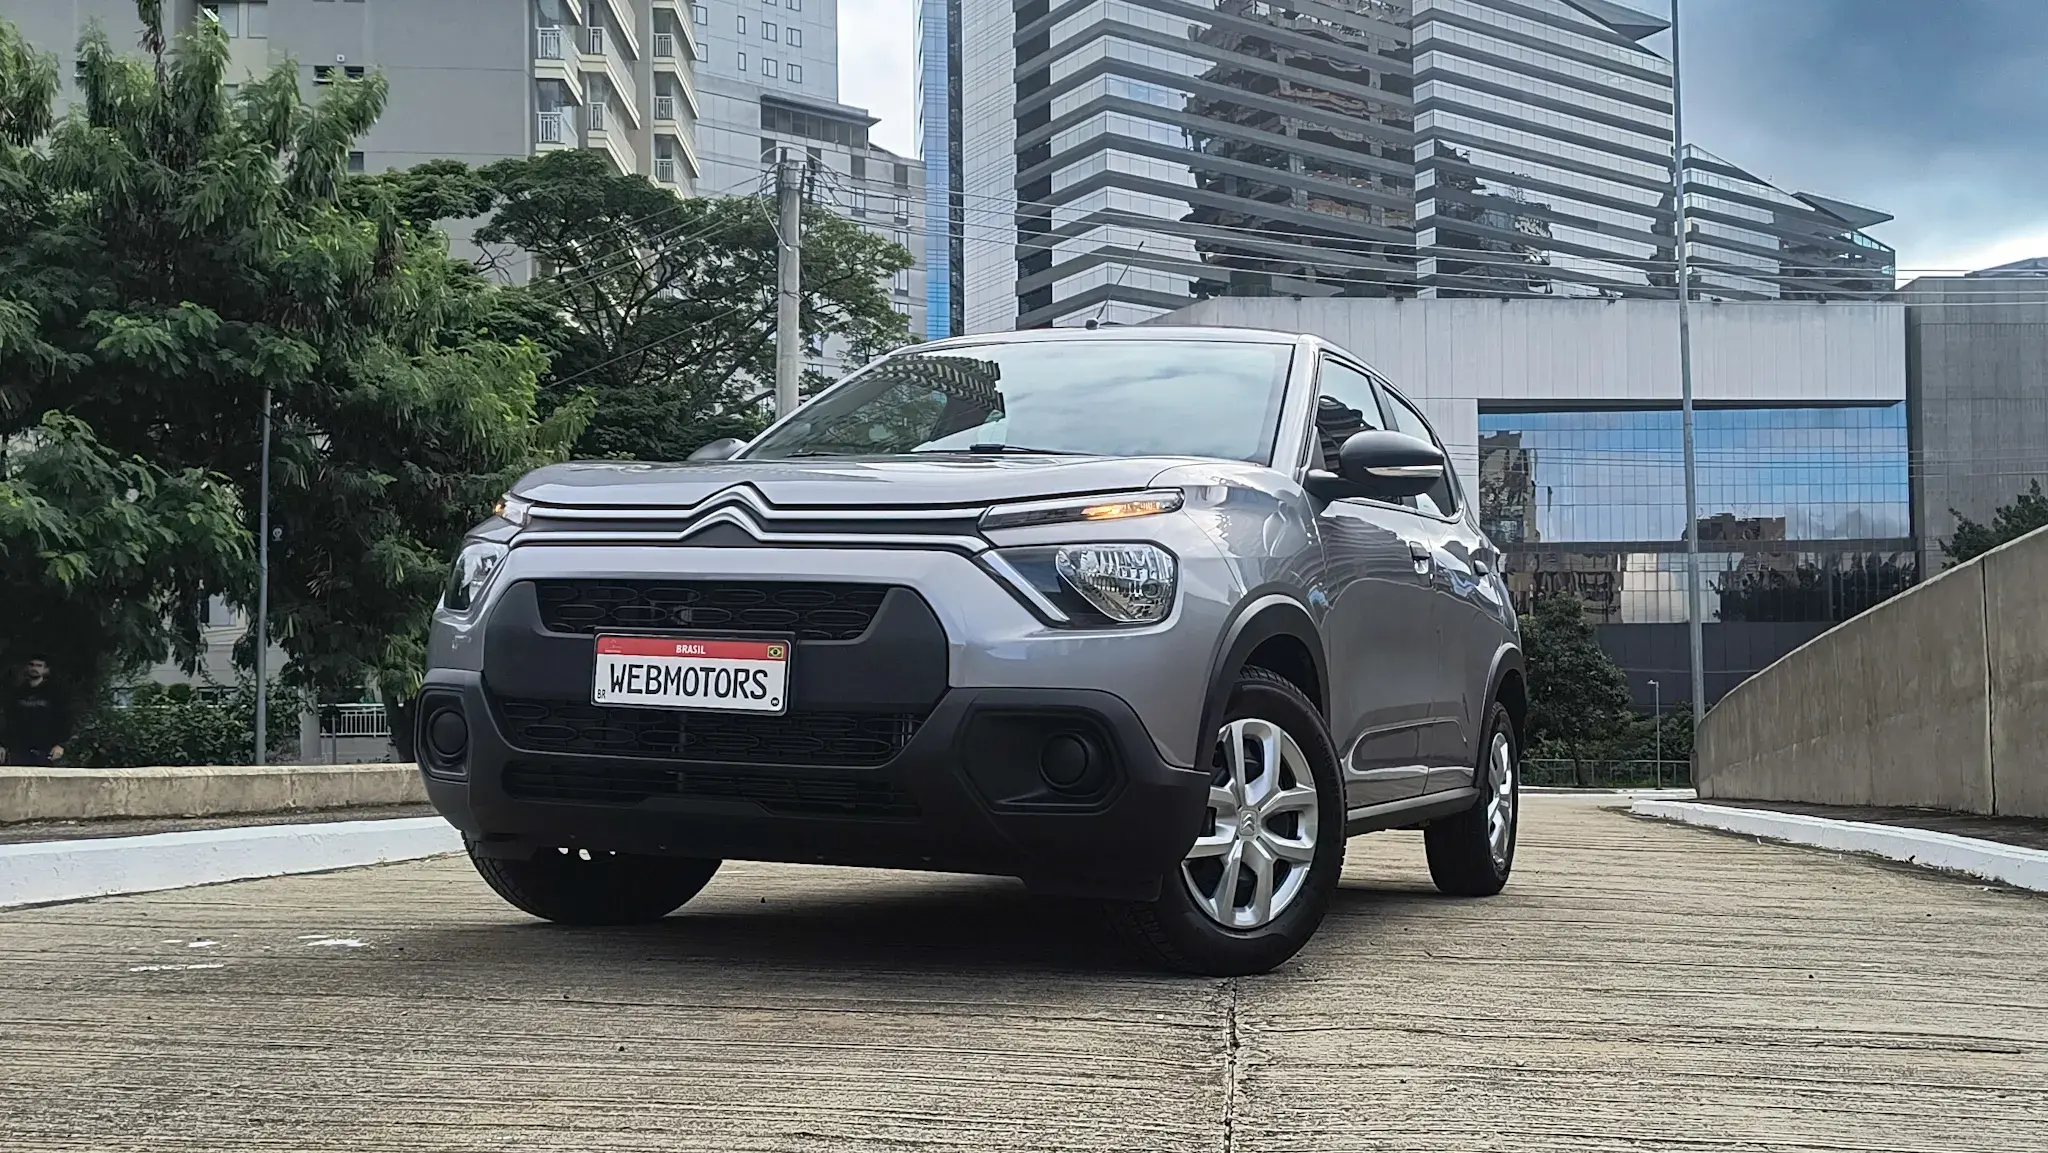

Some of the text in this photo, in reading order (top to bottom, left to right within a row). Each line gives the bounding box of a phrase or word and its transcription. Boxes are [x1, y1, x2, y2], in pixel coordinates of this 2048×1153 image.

[676, 644, 706, 655] BRASIL
[610, 663, 768, 700] WEBMOTORS
[597, 688, 606, 699] BR
